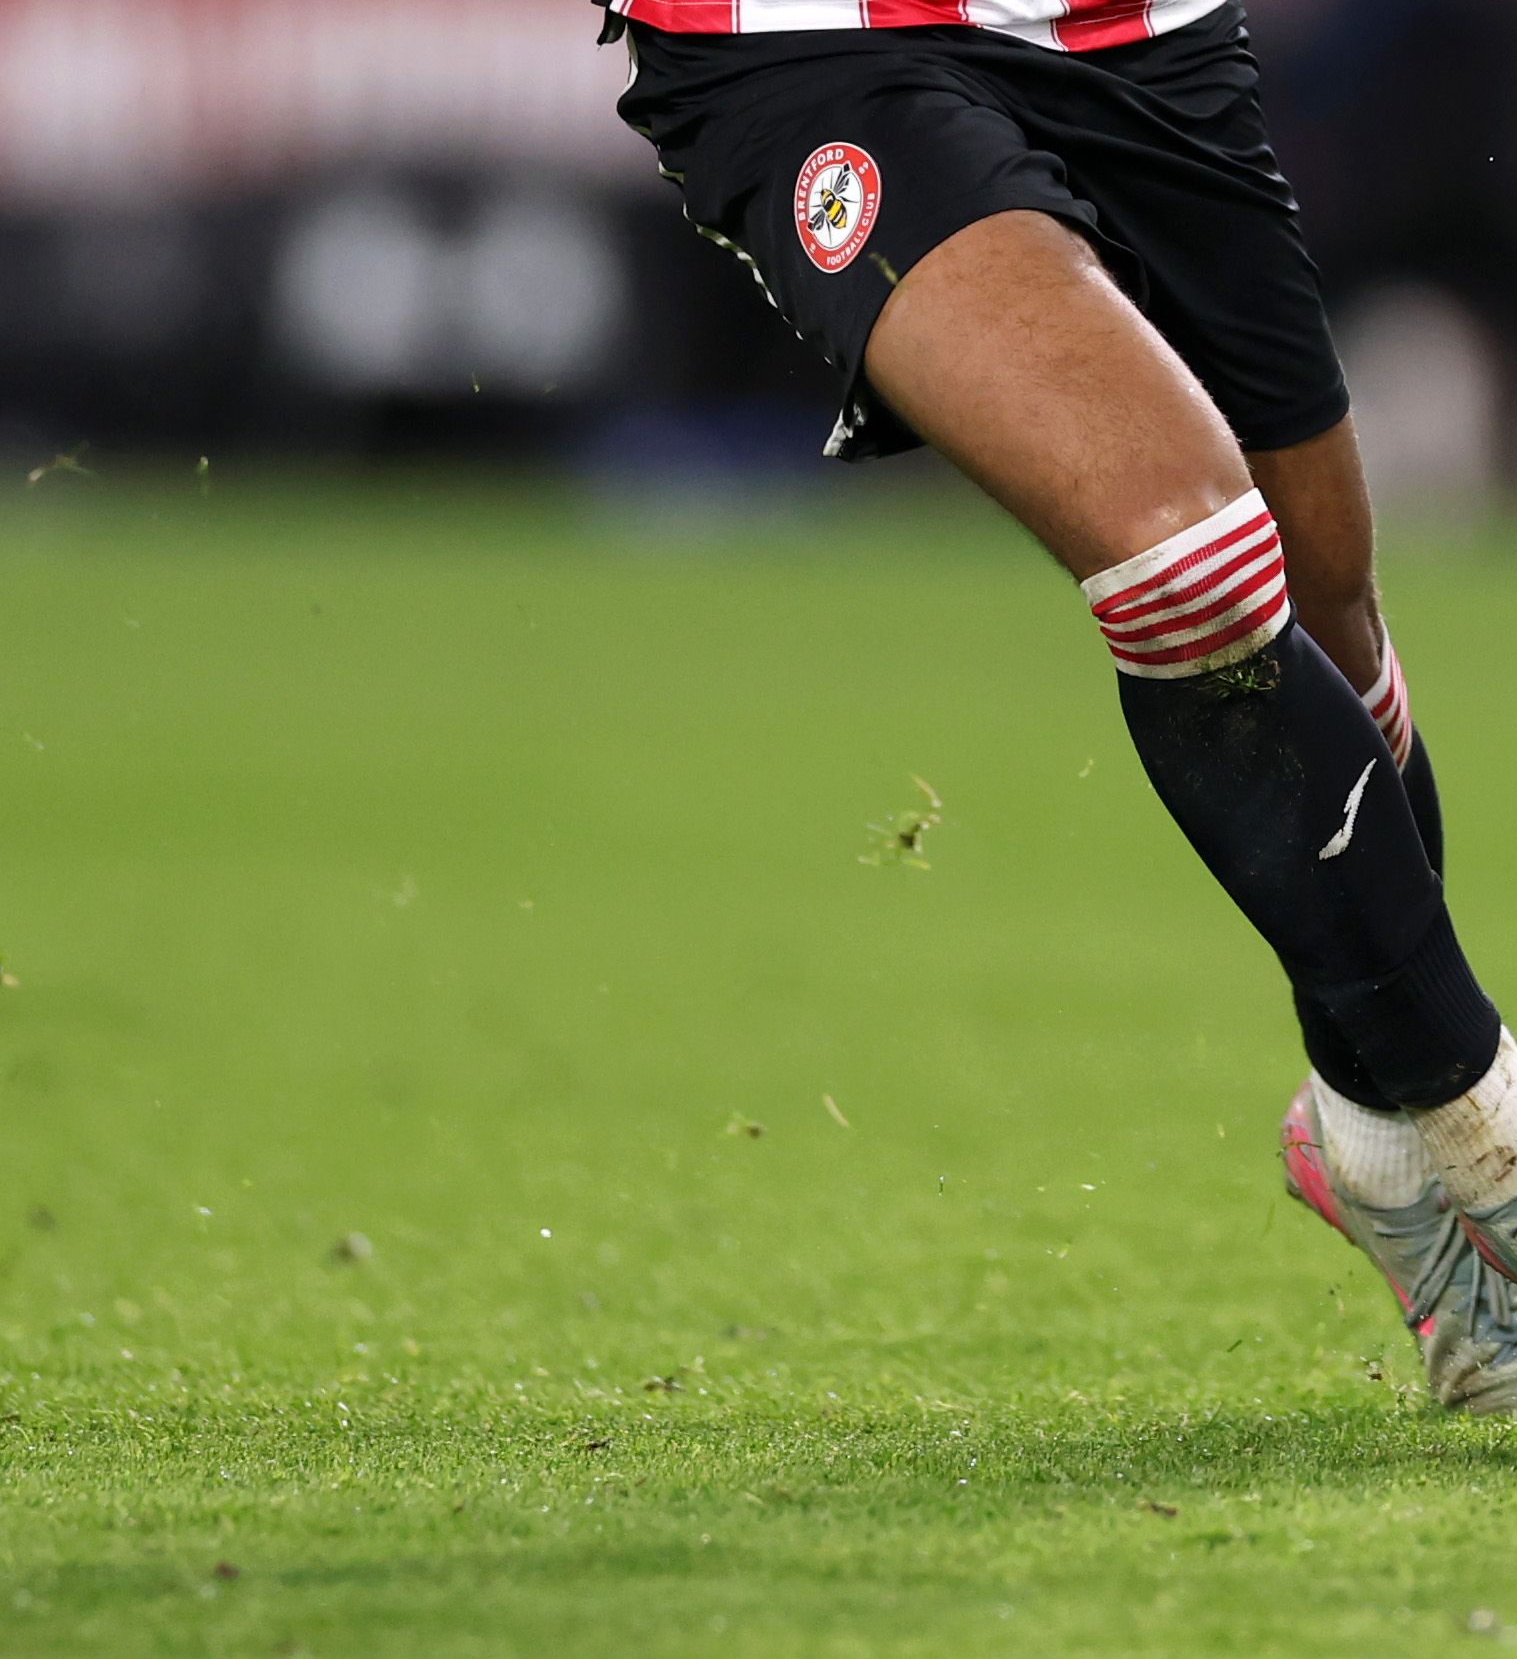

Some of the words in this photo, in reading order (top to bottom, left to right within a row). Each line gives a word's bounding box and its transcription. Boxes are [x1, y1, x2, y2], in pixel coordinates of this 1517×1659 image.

[797, 148, 845, 221] BRENTFORD
[827, 230, 865, 266] FOOTBALL
[861, 192, 876, 225] CLUB
